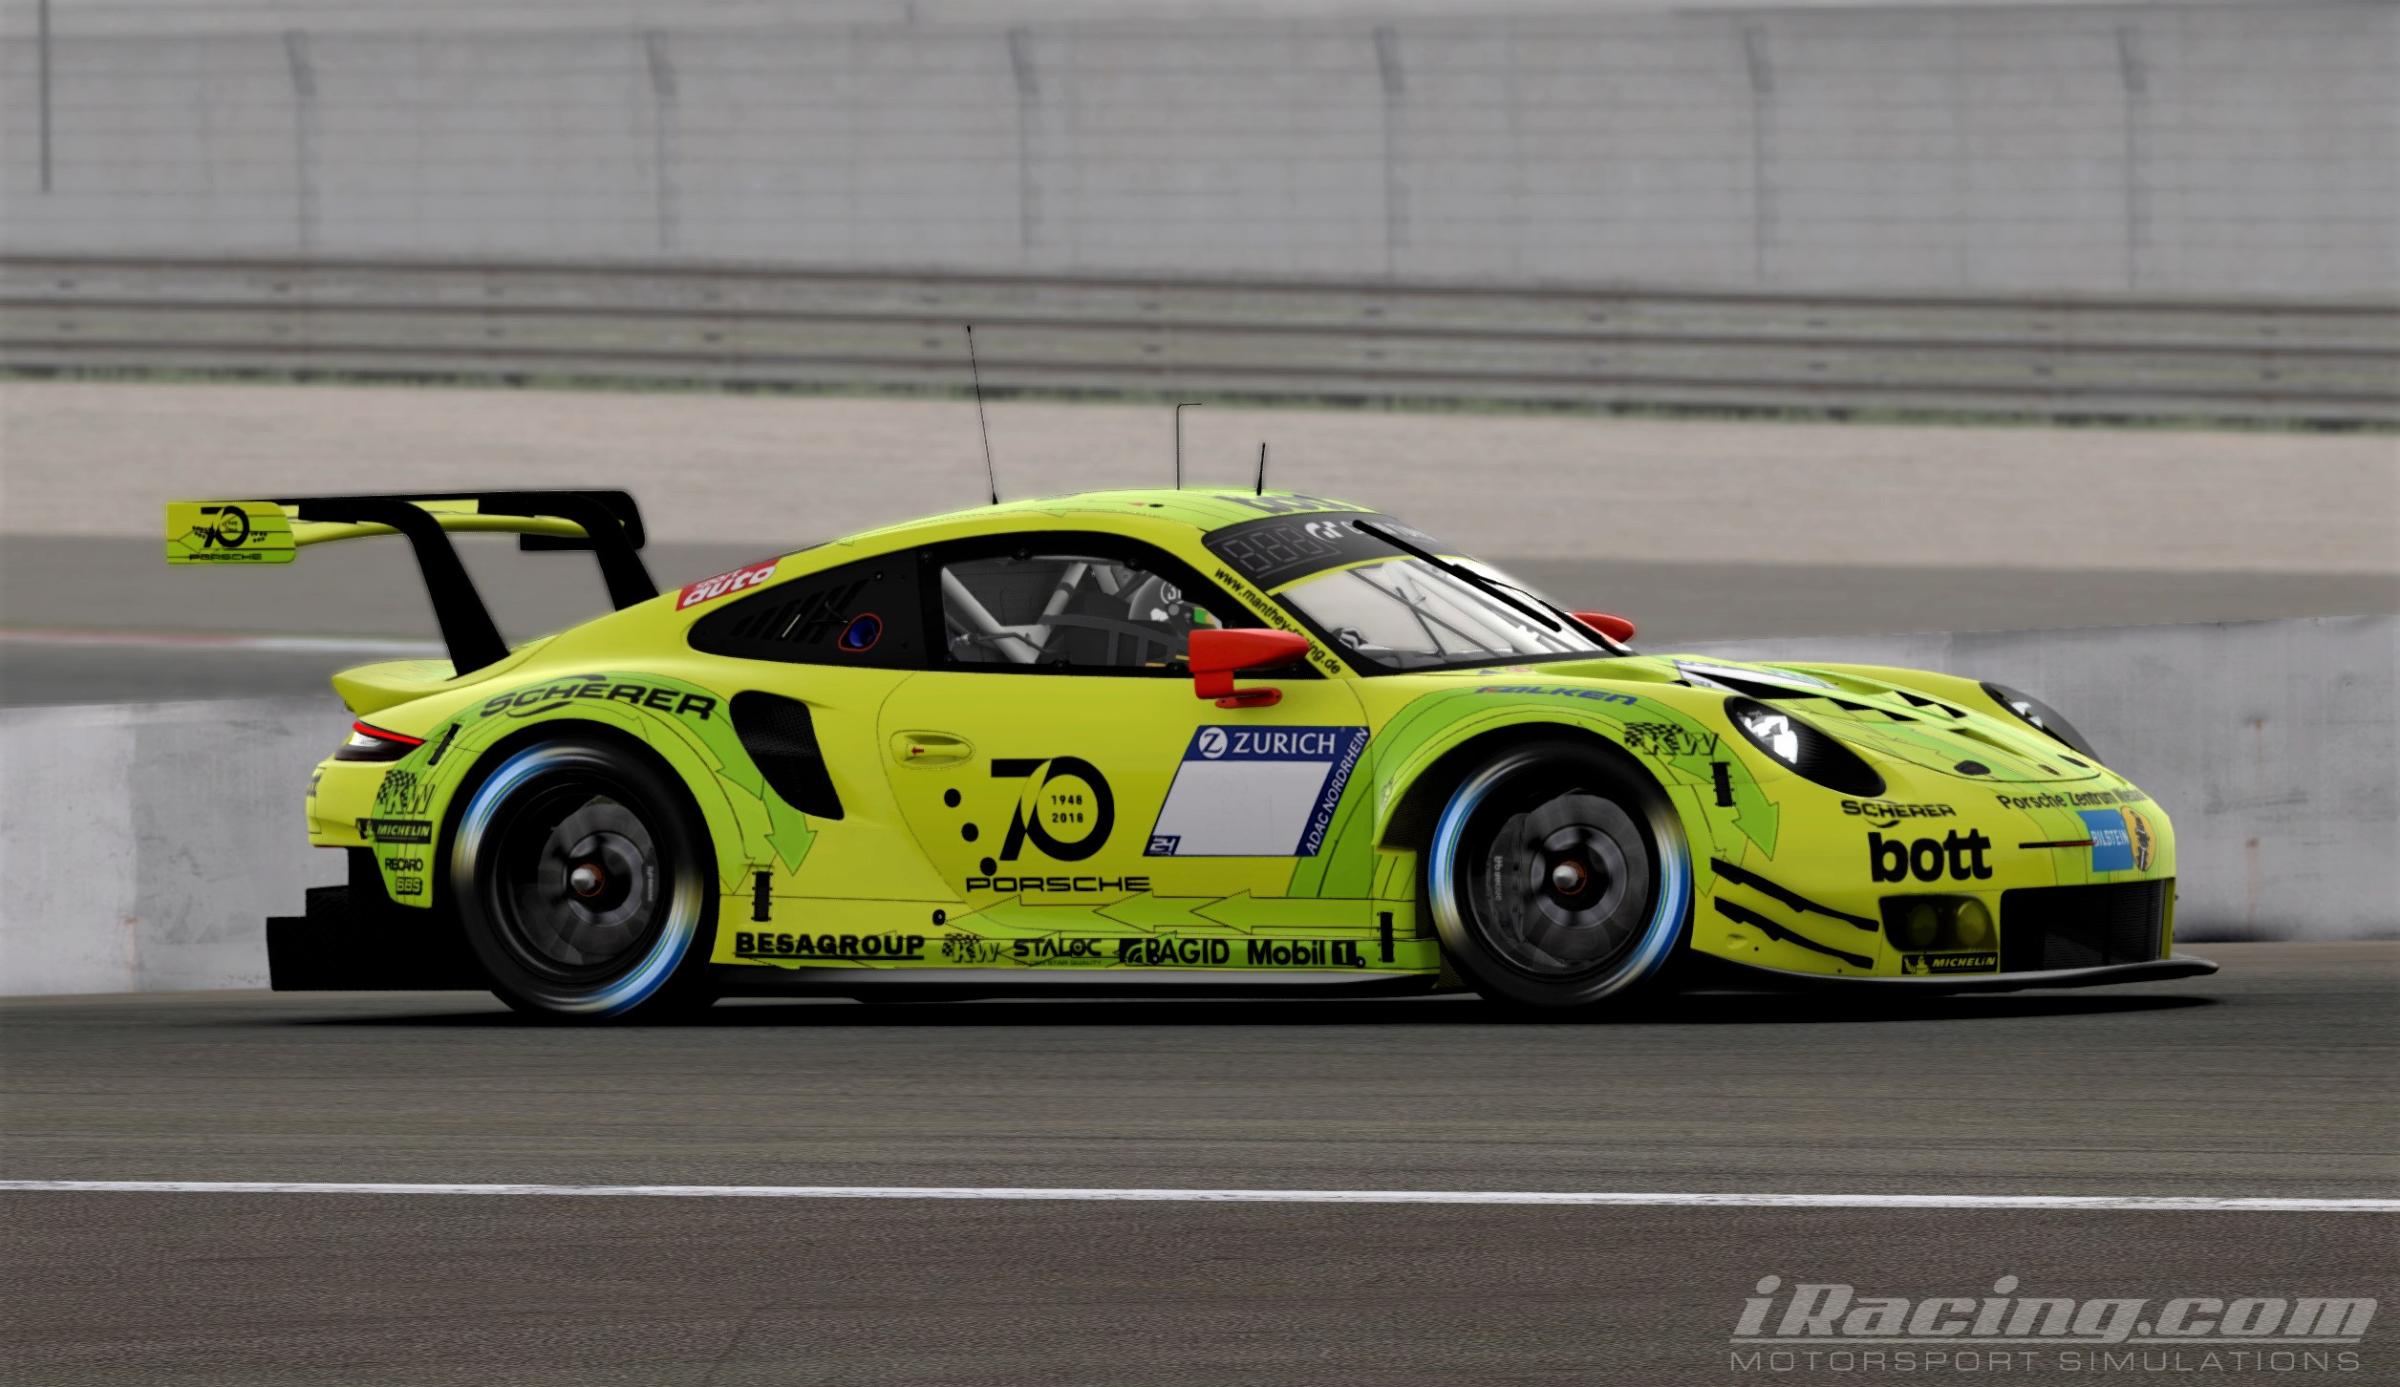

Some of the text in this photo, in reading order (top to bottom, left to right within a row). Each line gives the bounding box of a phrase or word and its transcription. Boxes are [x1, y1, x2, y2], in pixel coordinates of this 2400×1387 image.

[480, 682, 717, 721] SCHERER
[1475, 686, 1638, 706] FALKEN
[1232, 732, 1336, 755] ZURICH
[1052, 794, 1083, 806] 1948
[1306, 727, 1369, 855] ADAC NORDRHEIN
[991, 756, 1115, 862] 70
[1841, 799, 1956, 818] SCHERER
[1996, 793, 2068, 810] Porsche
[1052, 813, 1084, 824] 2018
[377, 824, 431, 838] MICHELIN
[2090, 828, 2130, 847] BILSTEIN
[385, 858, 423, 872] RECARO
[1868, 828, 1993, 883] bott
[966, 876, 1150, 893] PORSCHE
[735, 932, 925, 956] BESAGROUP
[1247, 938, 1326, 966] Mobil
[1932, 956, 1996, 968] MICHELIN
